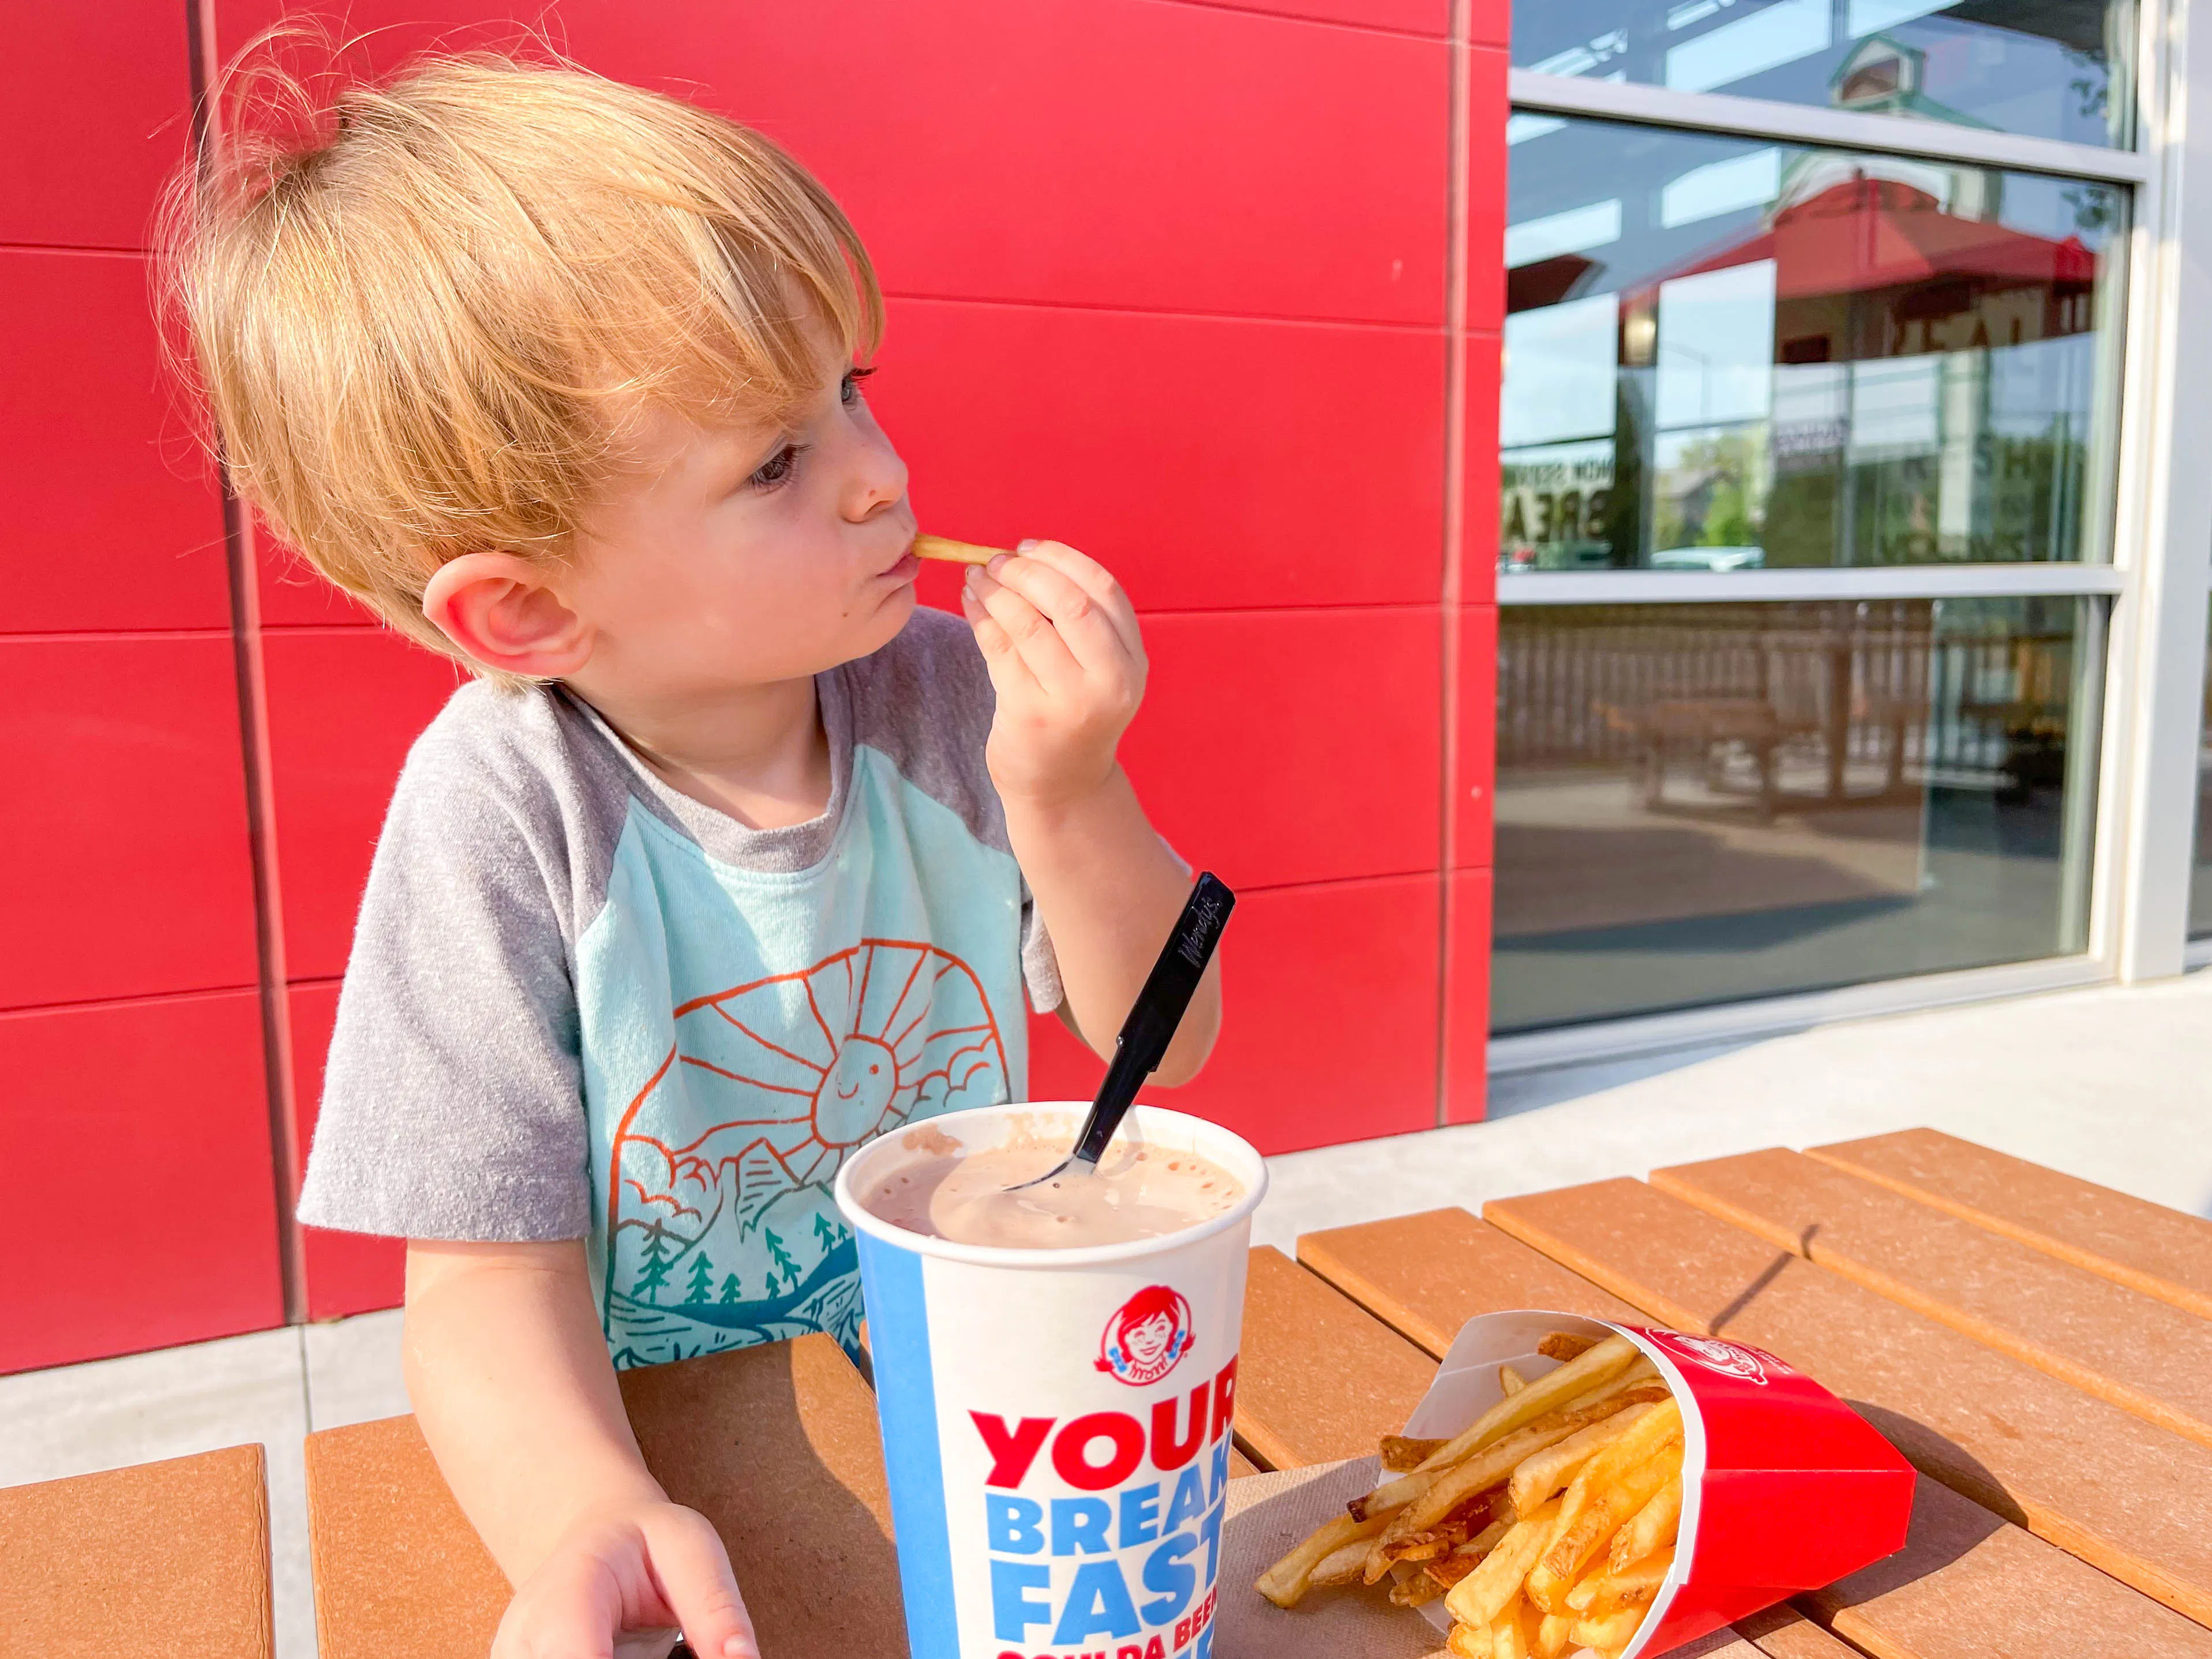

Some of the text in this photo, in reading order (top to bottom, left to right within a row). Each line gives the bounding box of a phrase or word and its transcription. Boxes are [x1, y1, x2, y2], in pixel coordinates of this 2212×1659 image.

[968, 1353, 1239, 1491] YOUR
[985, 1428, 1233, 1557] BREAK
[989, 1498, 1226, 1646] FAST
